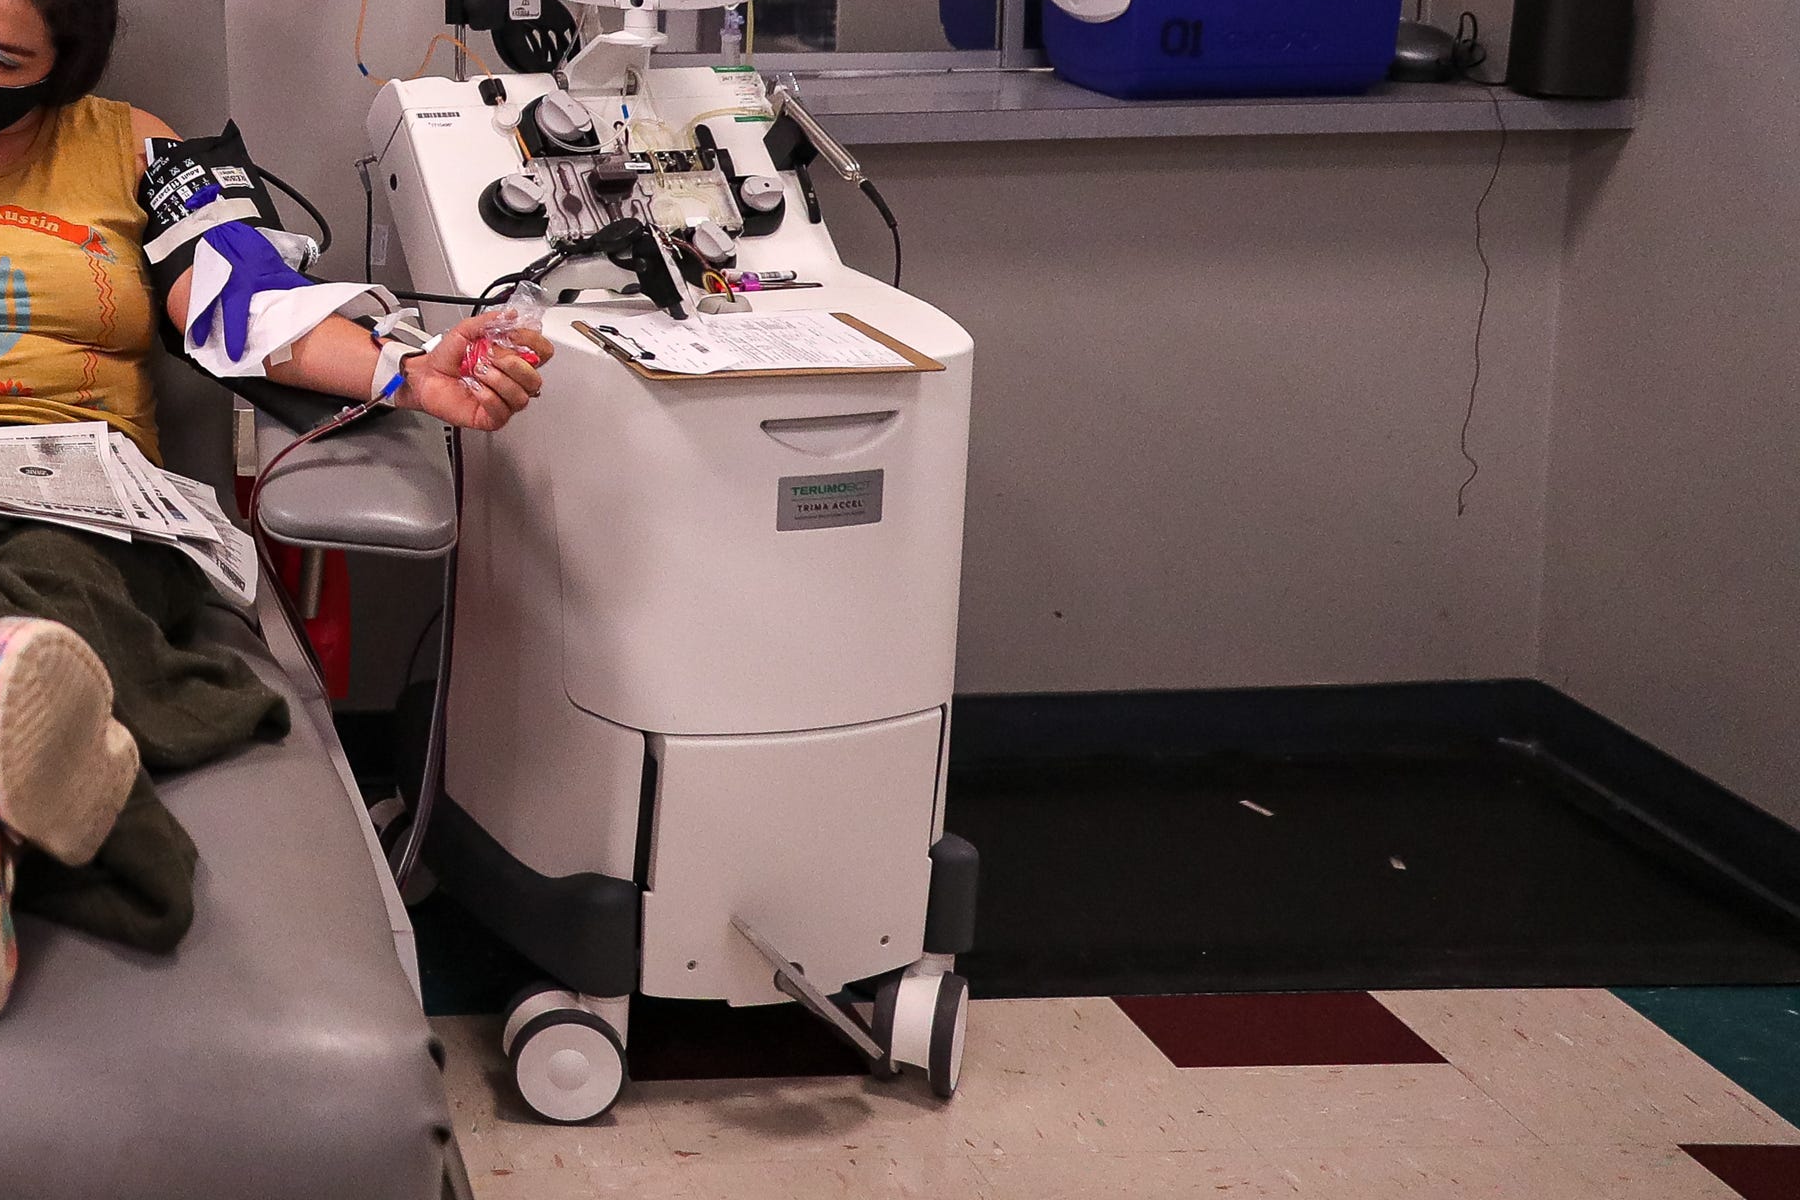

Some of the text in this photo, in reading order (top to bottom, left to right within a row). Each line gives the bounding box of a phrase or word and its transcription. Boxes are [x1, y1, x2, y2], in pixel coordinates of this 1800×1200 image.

[181, 167, 200, 181] Adult
[797, 500, 863, 513] TRIMA ACCEL
